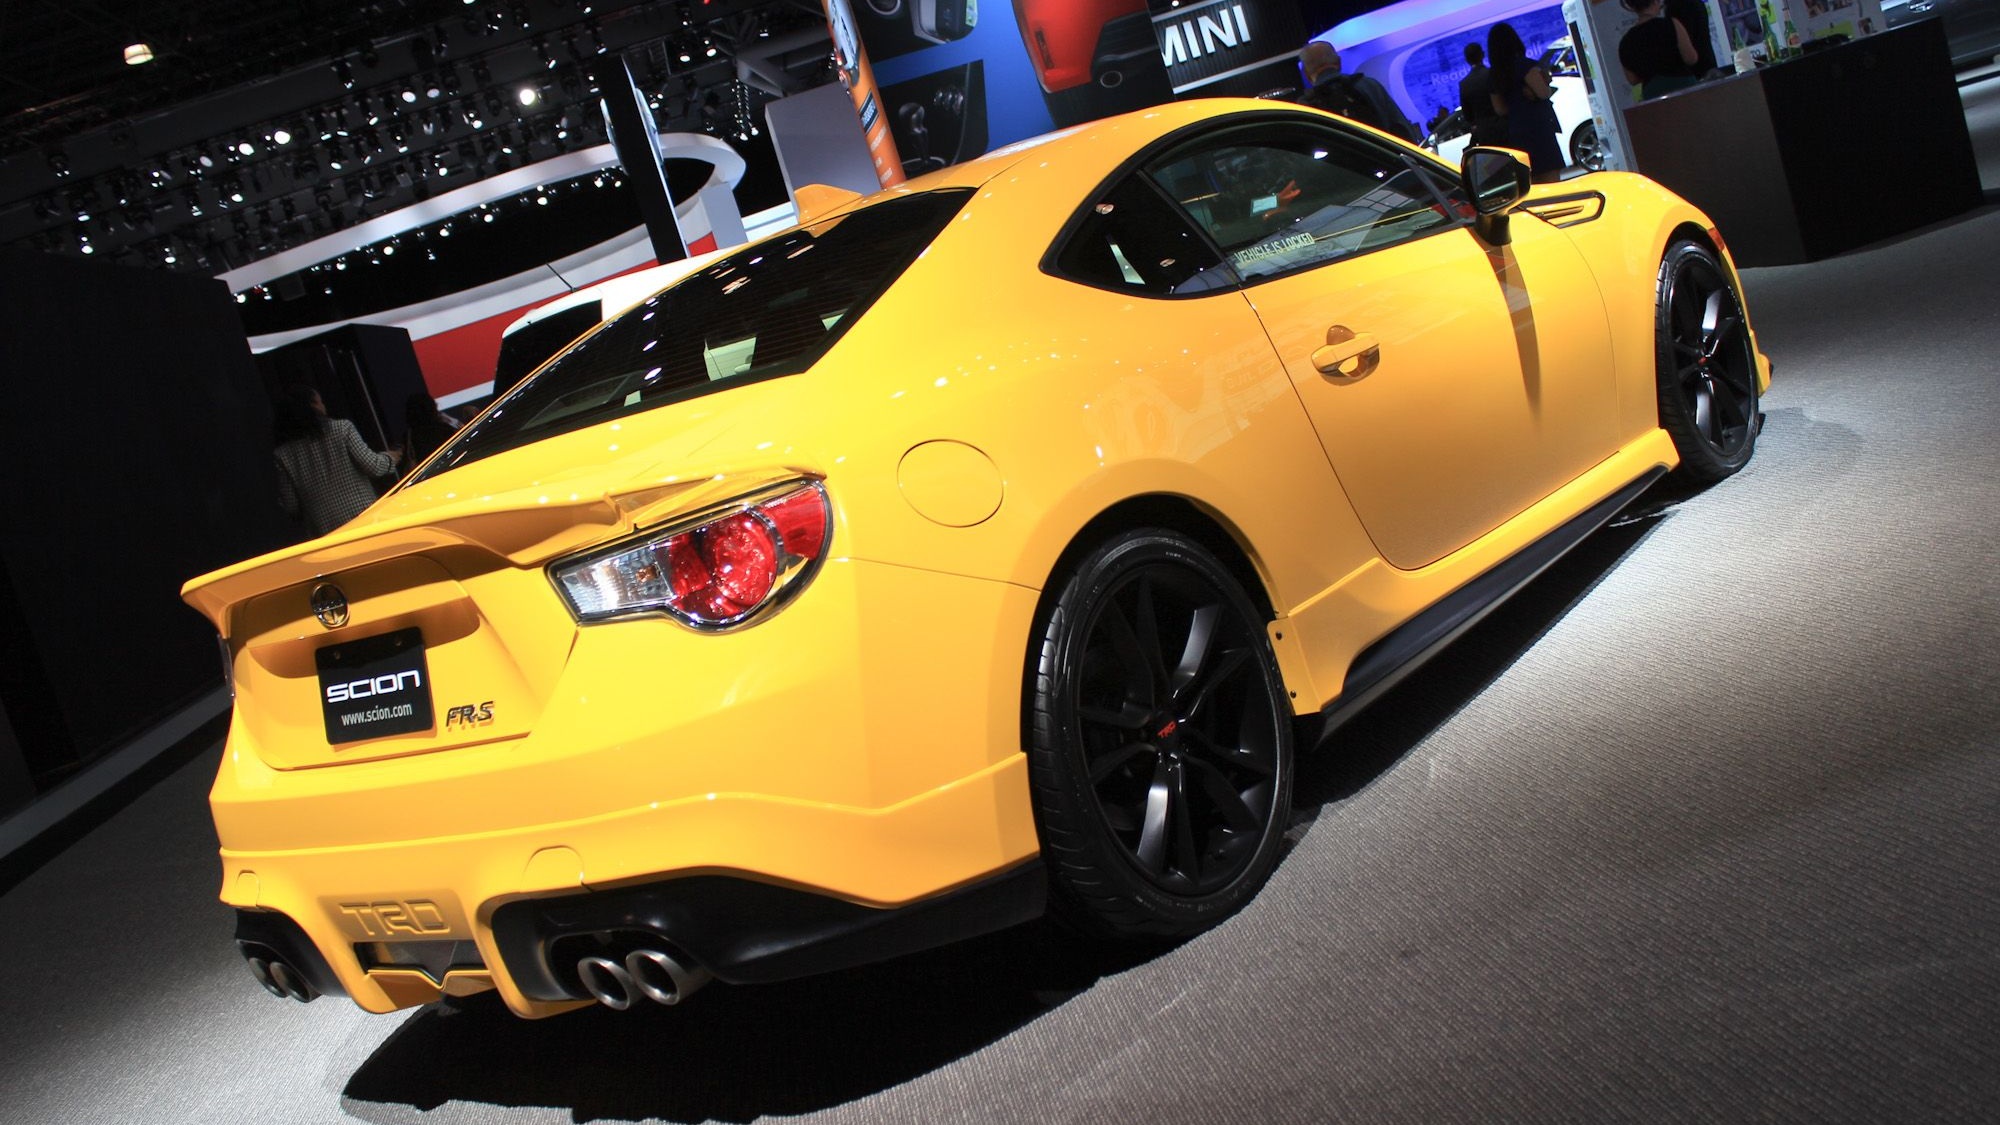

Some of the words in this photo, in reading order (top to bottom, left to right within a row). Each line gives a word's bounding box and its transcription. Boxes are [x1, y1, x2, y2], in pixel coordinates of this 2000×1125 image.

[1161, 5, 1251, 67] MINI
[1430, 67, 1472, 86] Read
[1234, 243, 1271, 263] VEHICLE
[1272, 241, 1281, 255] IS
[1281, 232, 1315, 251] LOCKED
[341, 702, 413, 727] www.scion.com
[339, 898, 450, 935] TRD
